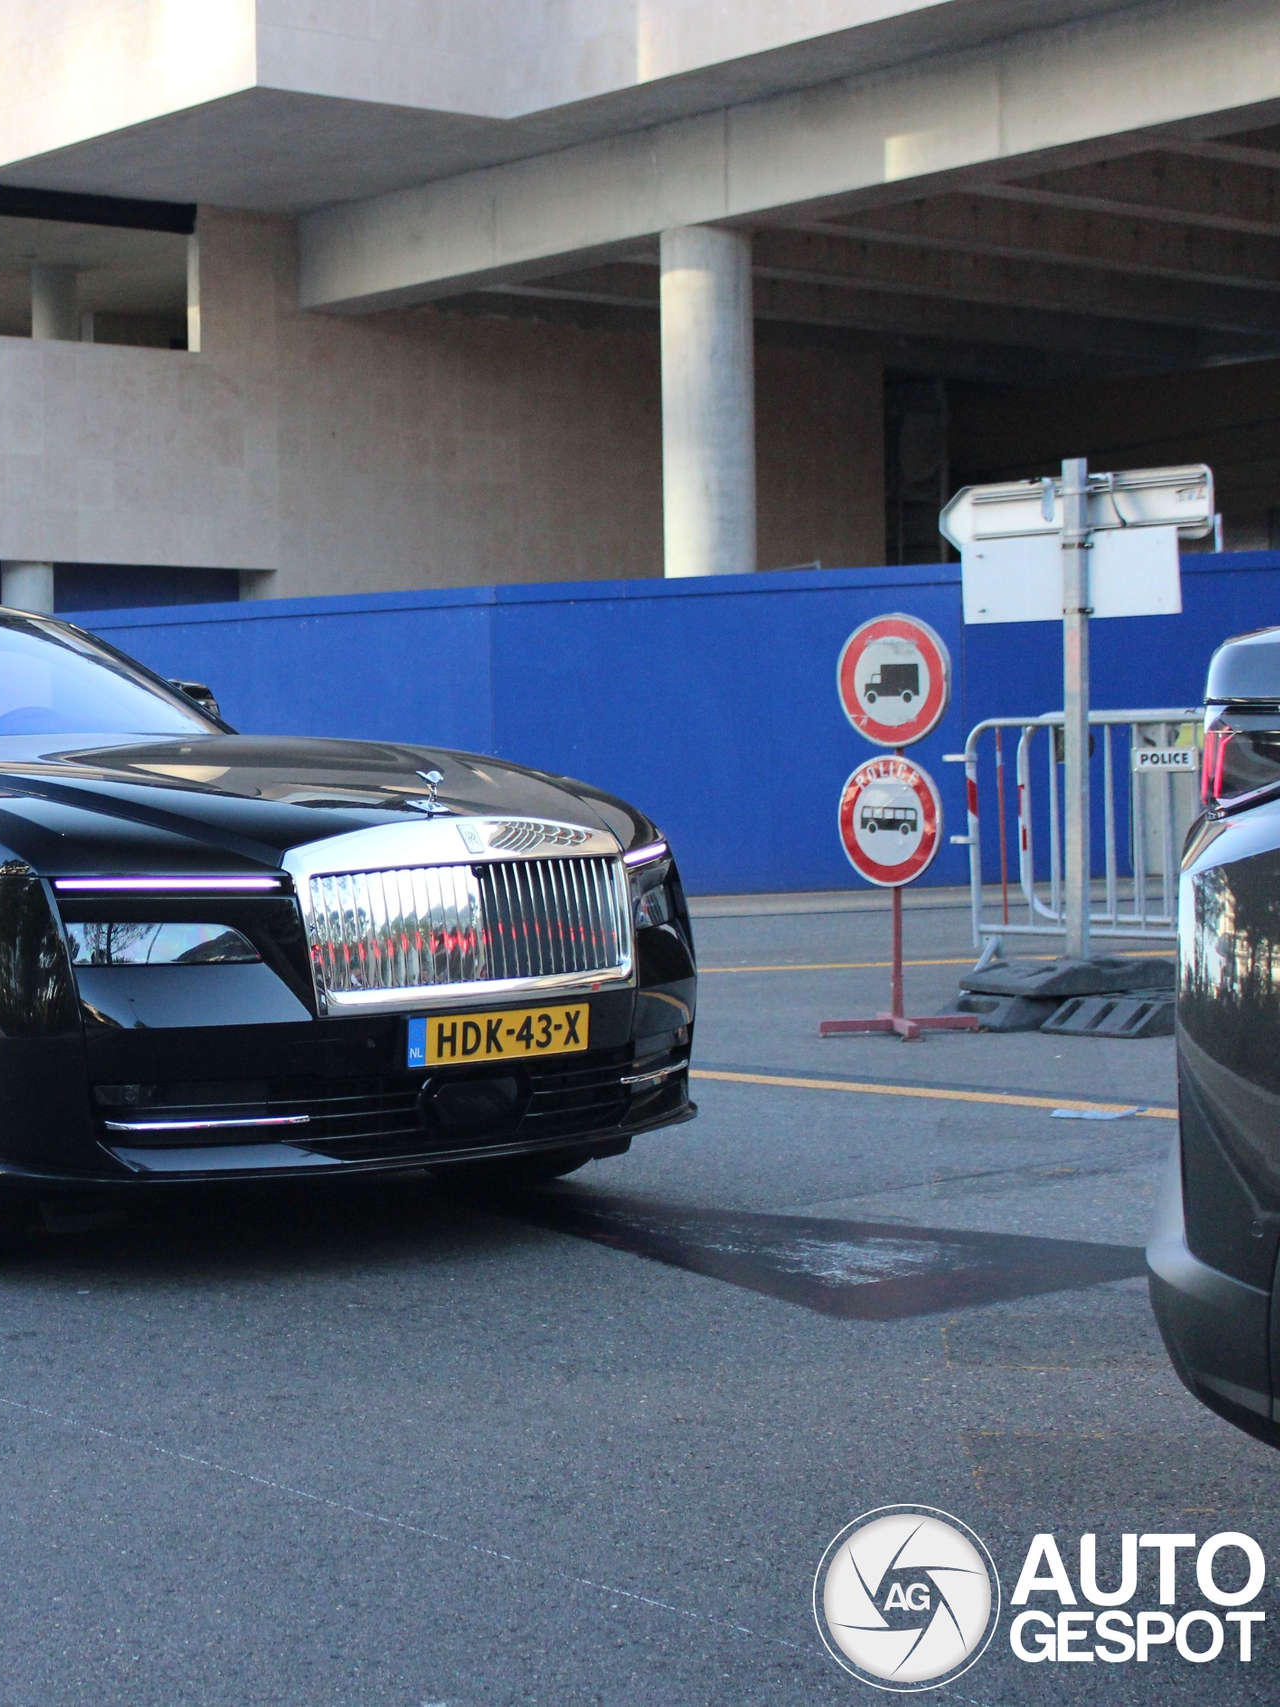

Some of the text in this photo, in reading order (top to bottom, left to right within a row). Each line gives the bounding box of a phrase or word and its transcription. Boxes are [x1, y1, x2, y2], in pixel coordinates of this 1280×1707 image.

[1140, 752, 1189, 765] POLICE
[854, 761, 920, 791] POLICE
[436, 1010, 581, 1058] HDK-43-X
[409, 1047, 423, 1059] NL
